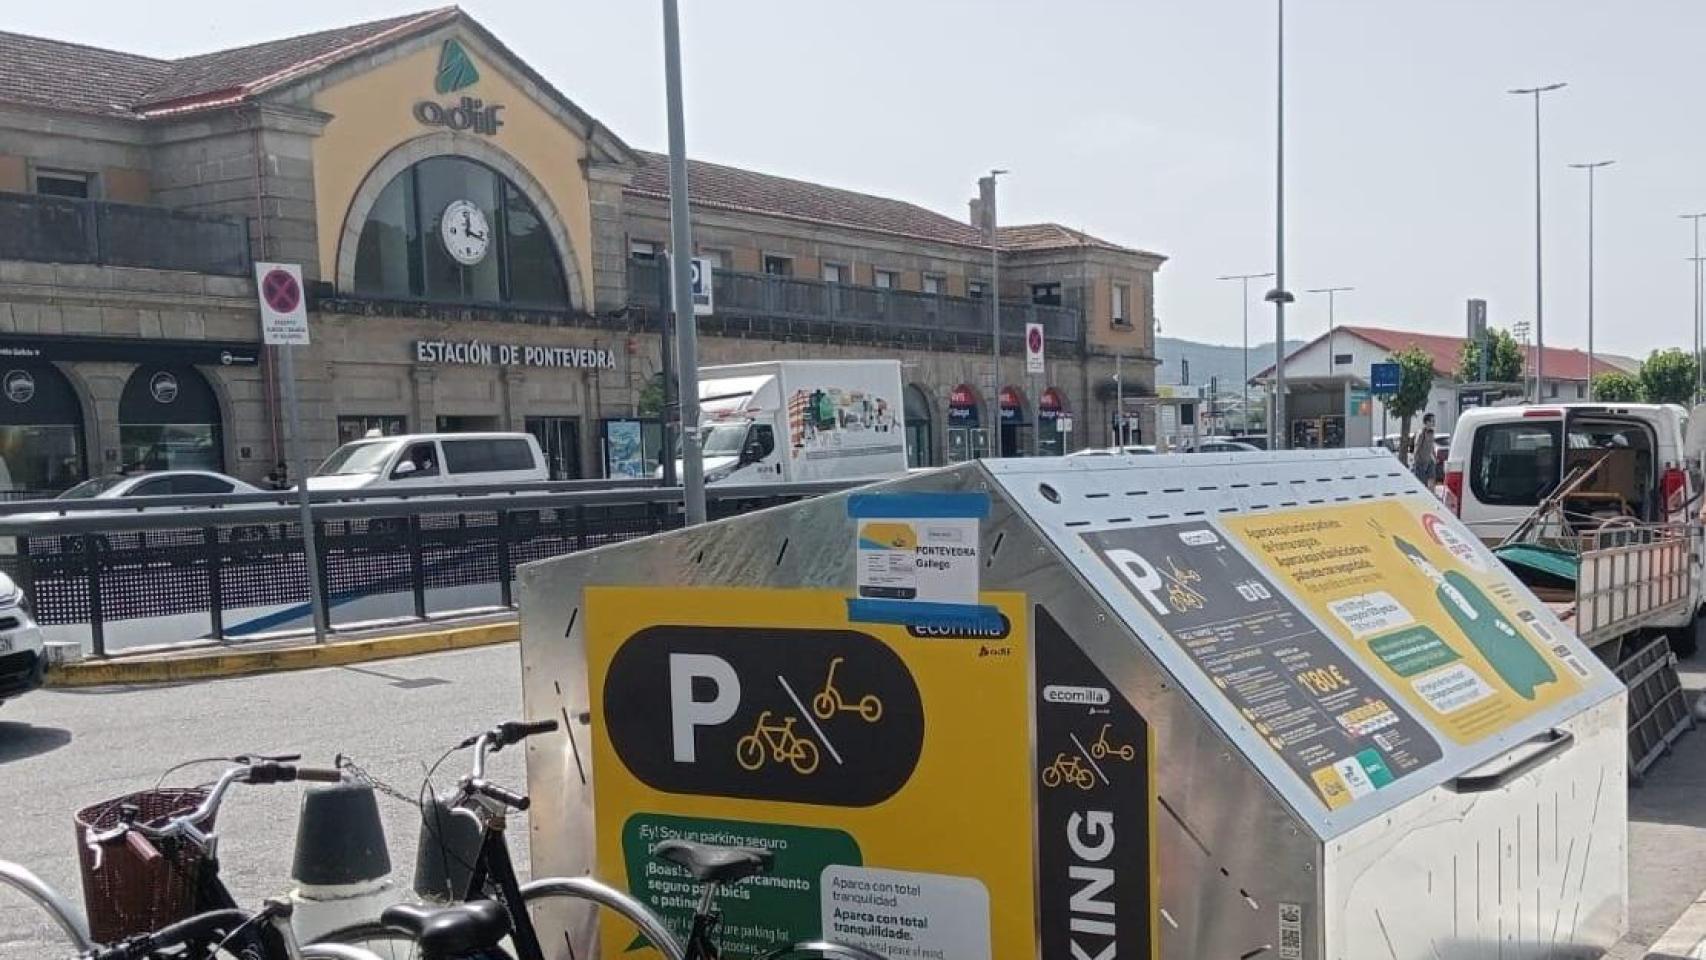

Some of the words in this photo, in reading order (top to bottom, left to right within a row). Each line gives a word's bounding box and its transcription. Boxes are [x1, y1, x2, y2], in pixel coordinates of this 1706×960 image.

[417, 340, 491, 364] ESTACIÓN
[500, 345, 520, 365] DE
[525, 346, 616, 369] PONTEVEDRA
[916, 546, 976, 557] PONTEVEDRA
[1104, 549, 1171, 615] P
[1049, 690, 1103, 703] ecomilla
[670, 653, 741, 763] P
[660, 826, 680, 840] Soy
[700, 832, 743, 847] parking
[745, 836, 787, 850] seguro
[646, 861, 682, 877] ¡Boas!
[648, 879, 690, 894] seguro
[692, 883, 720, 897] pa
[721, 884, 750, 900] bicis
[736, 874, 811, 891] arcamento
[832, 875, 871, 891] Aparca
[872, 882, 893, 893] con
[895, 884, 921, 897] total
[834, 906, 874, 922] Aparca
[876, 913, 898, 925] con
[900, 915, 928, 929] total
[834, 921, 913, 941] tranquilidade.
